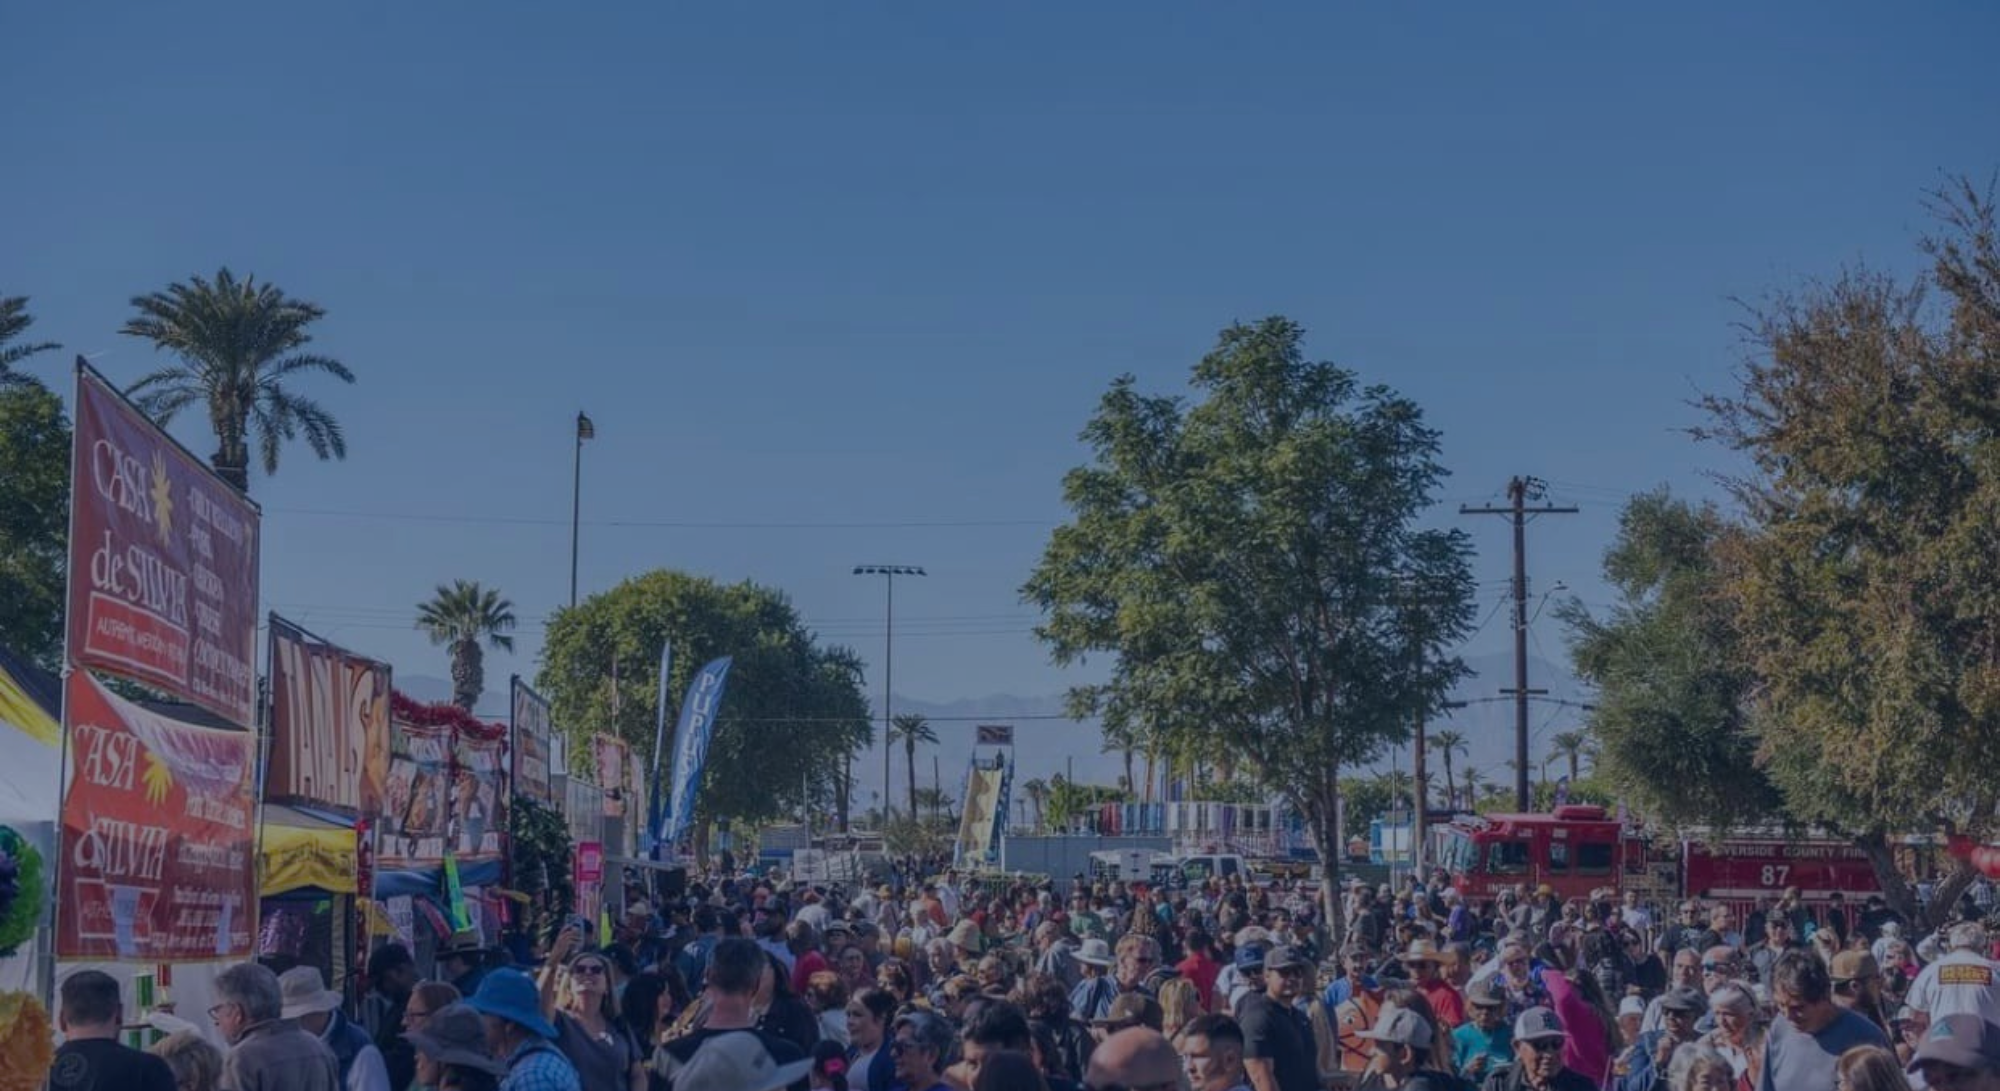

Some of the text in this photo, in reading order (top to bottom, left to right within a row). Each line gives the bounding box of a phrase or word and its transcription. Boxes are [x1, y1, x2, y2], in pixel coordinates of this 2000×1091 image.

[93, 440, 151, 523] CASA
[91, 529, 188, 628] de SILVIA
[1711, 845, 1776, 858] VERSIDE
[1783, 847, 1835, 858] COUNTY
[1761, 865, 1790, 886] 87
